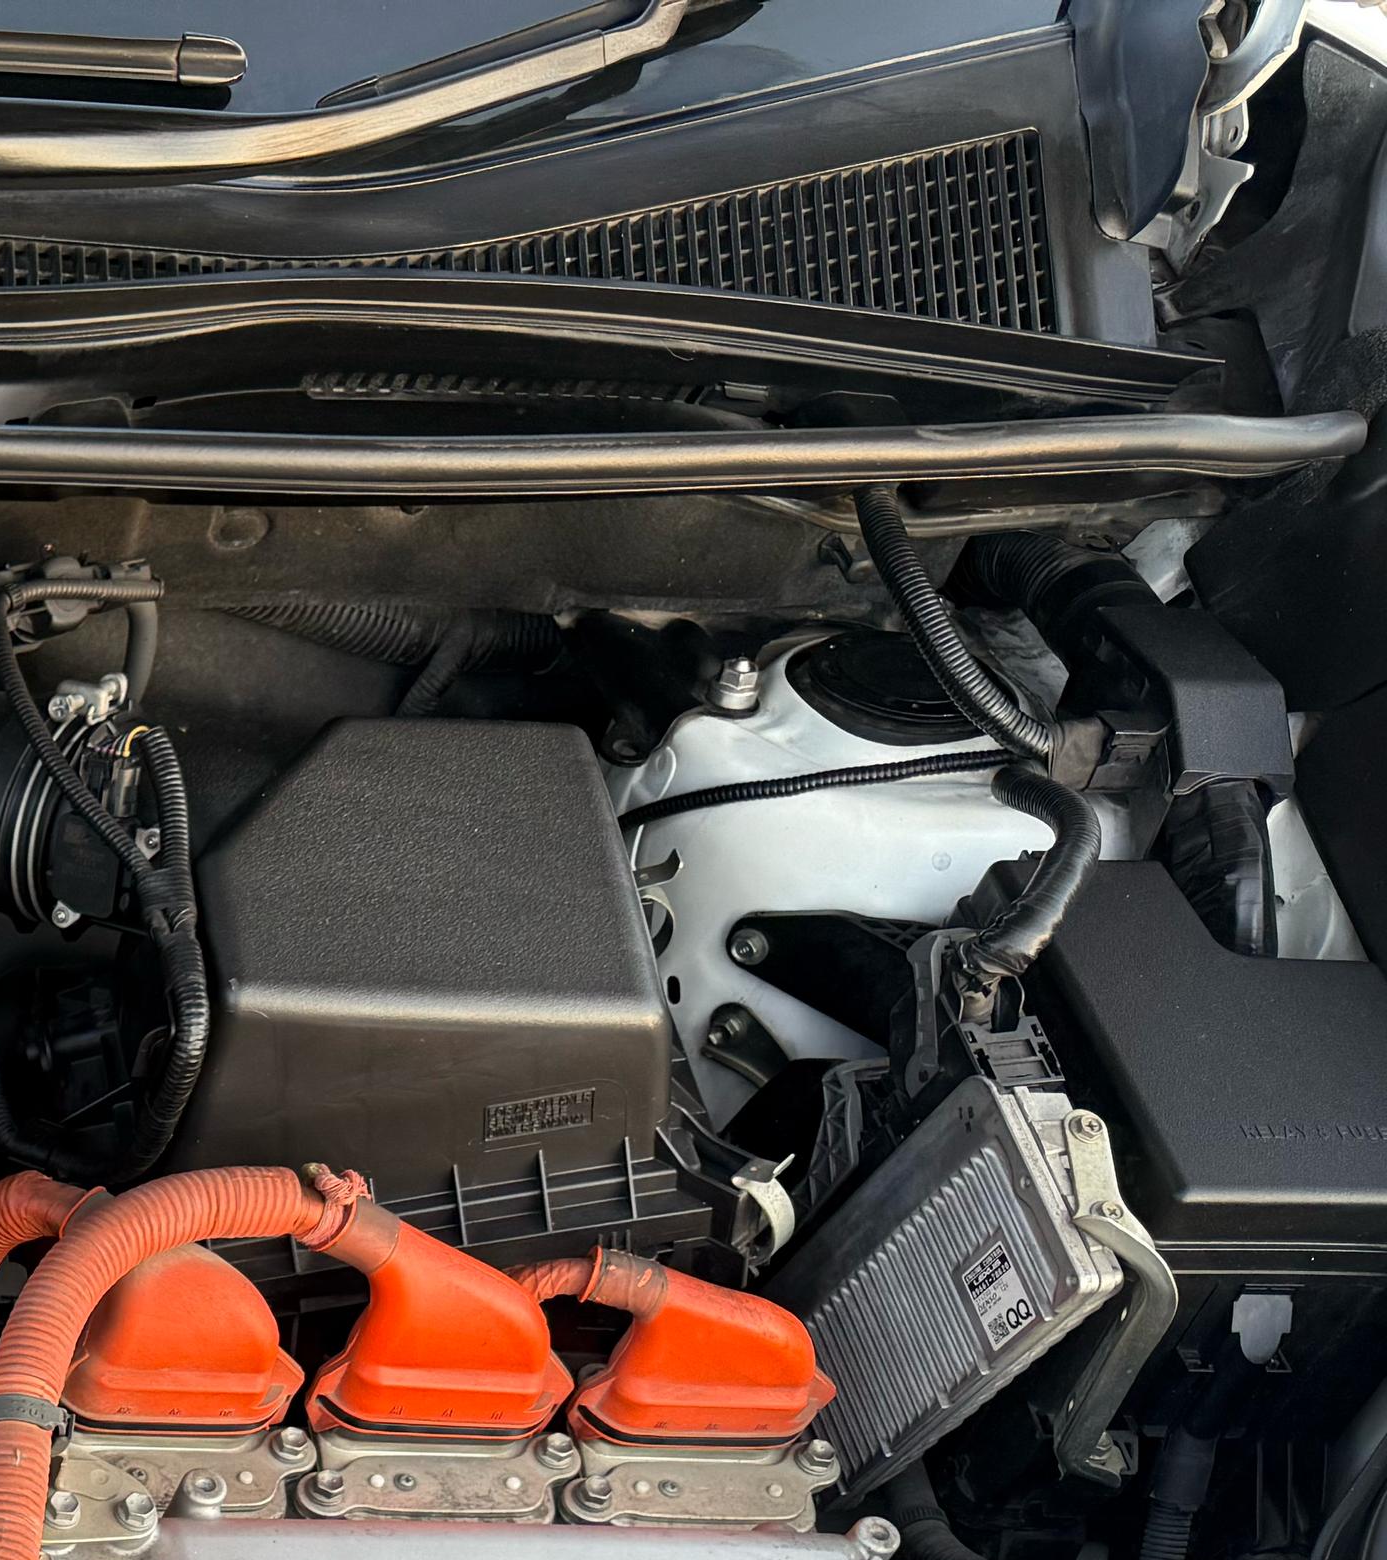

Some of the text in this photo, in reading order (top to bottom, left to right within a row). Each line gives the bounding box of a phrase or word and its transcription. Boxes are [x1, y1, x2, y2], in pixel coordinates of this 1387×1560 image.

[1238, 1124, 1307, 1140] RELAY
[973, 1259, 1001, 1286] LEXUS
[978, 1292, 997, 1312] DENSO
[1006, 1298, 1033, 1329] QQ
